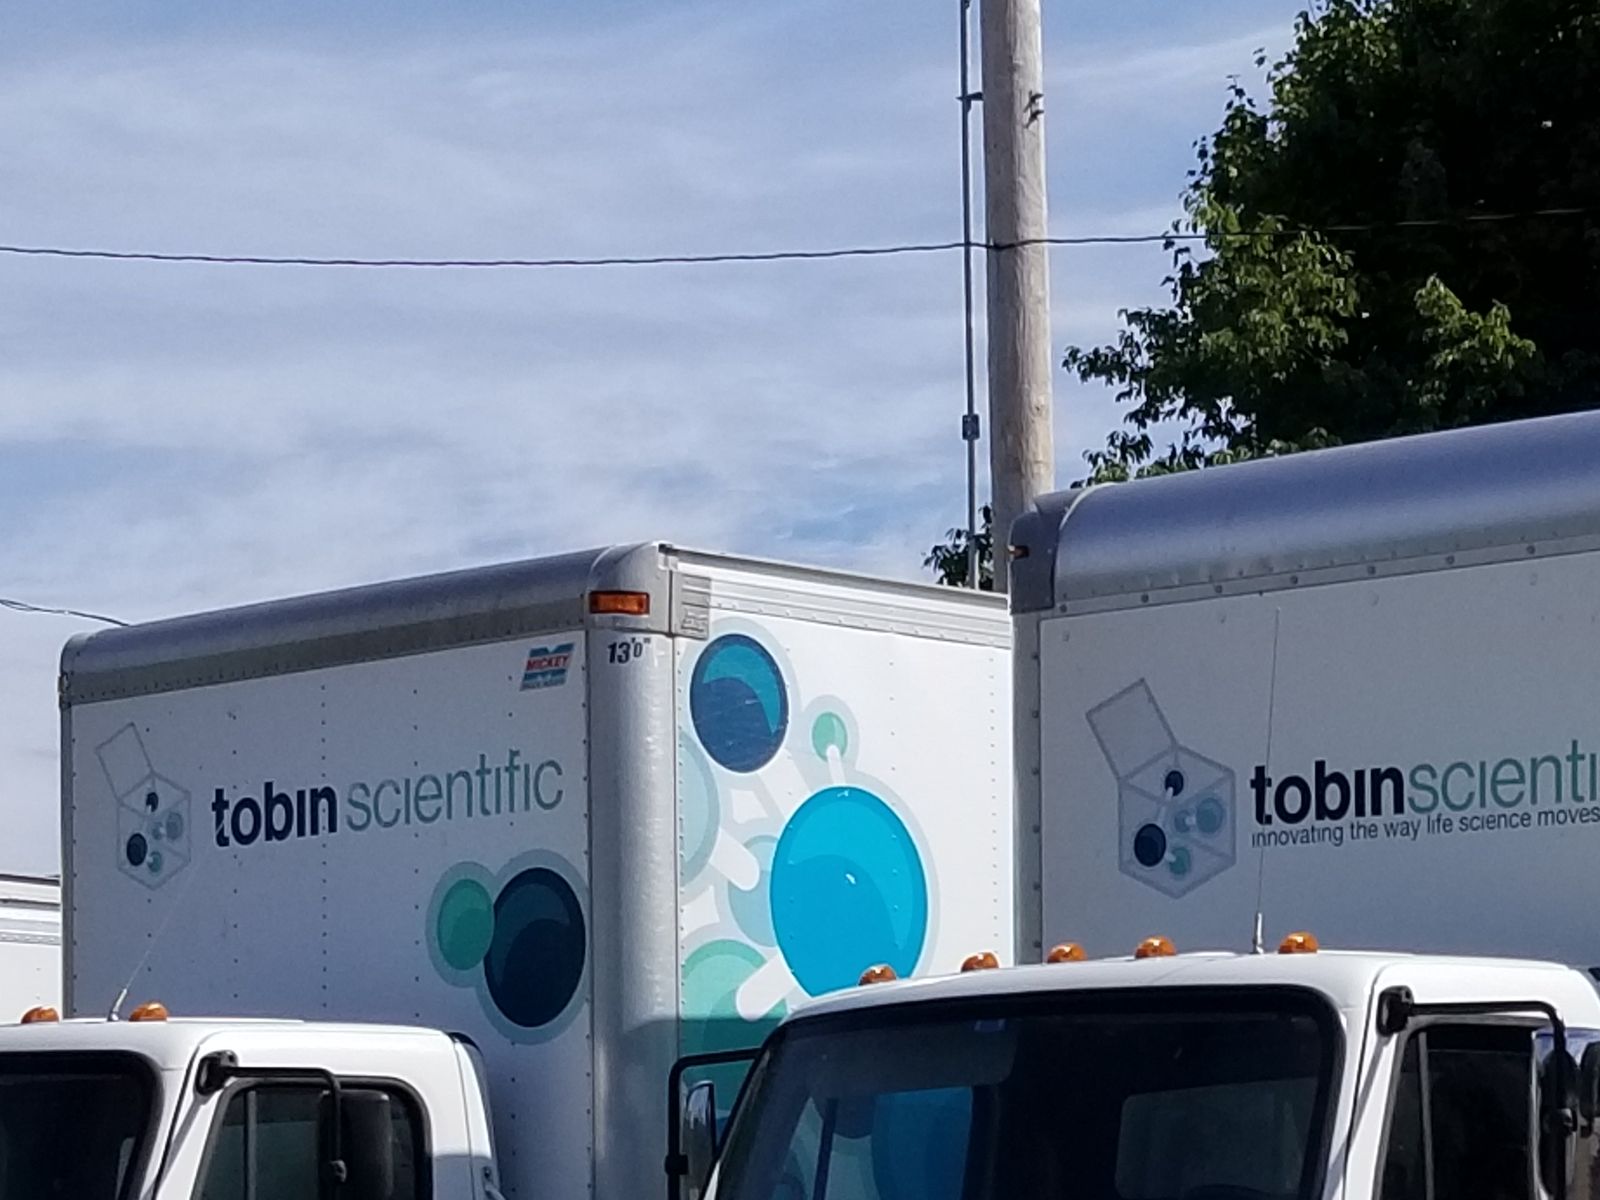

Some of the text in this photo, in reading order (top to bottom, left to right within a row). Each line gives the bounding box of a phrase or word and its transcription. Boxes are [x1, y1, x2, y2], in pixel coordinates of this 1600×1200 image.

[1251, 806, 1600, 848] innovating the way life science moves
